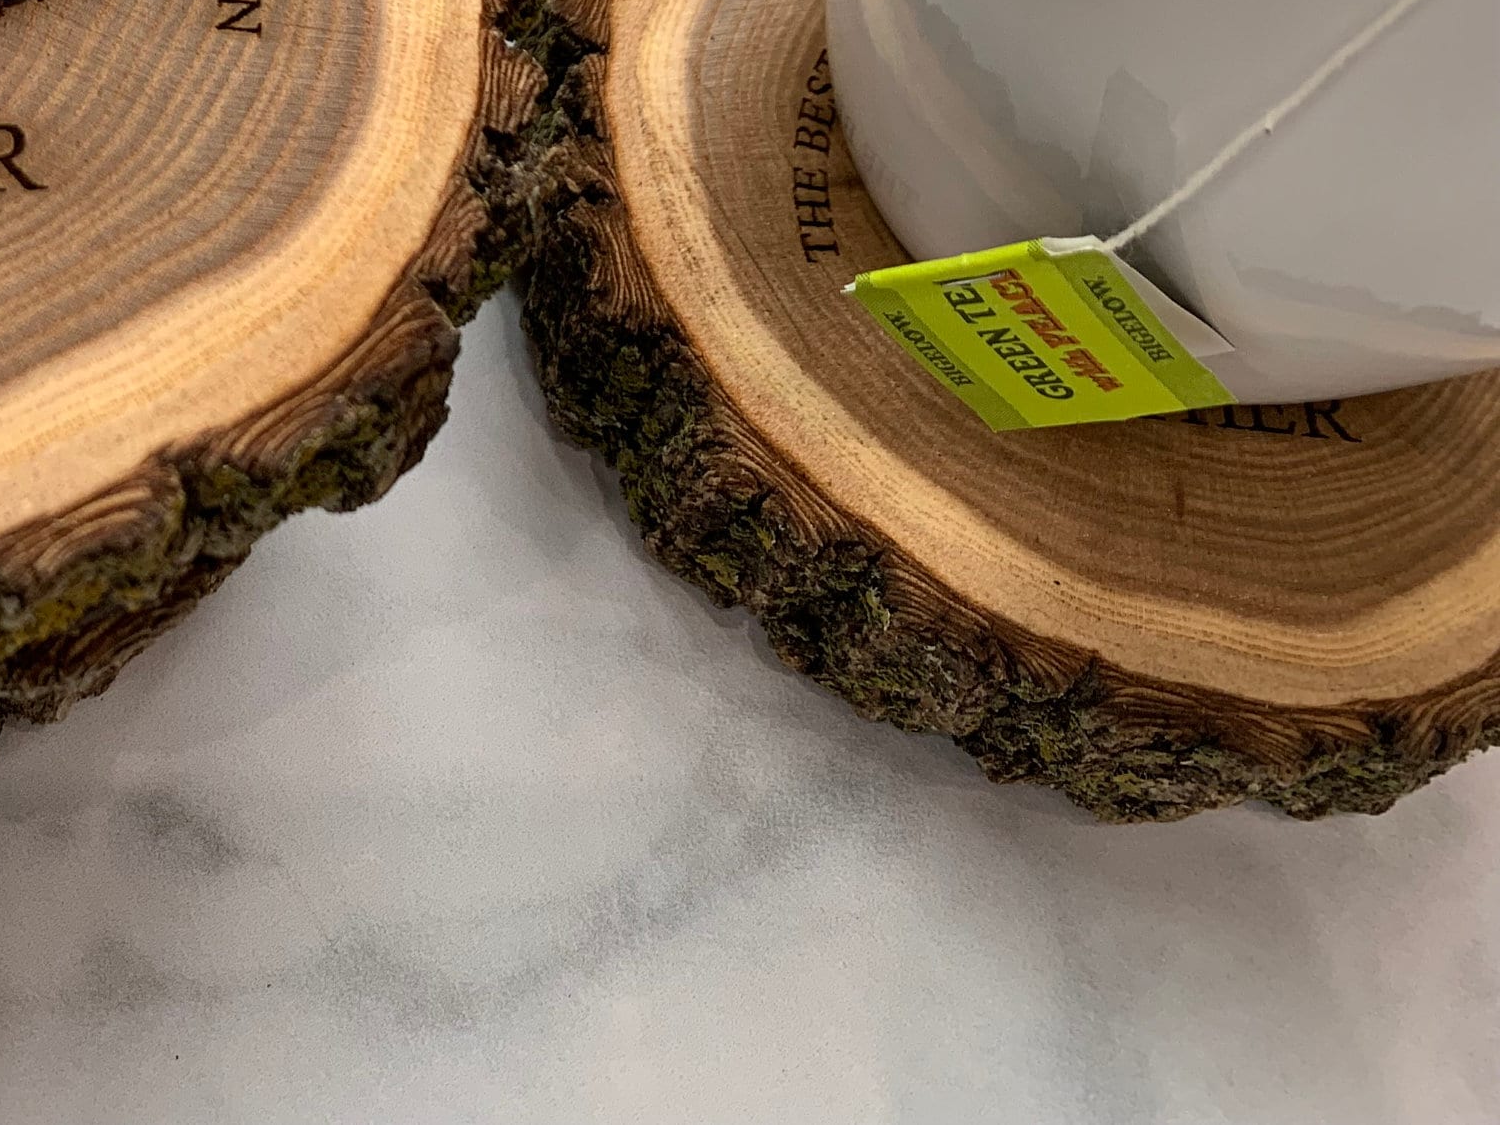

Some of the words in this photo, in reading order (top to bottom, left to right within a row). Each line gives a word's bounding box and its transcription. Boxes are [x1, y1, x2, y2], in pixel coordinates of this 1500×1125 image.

[793, 167, 841, 263] THE
[934, 277, 998, 324] TE
[1082, 276, 1175, 363] BIGELOW
[882, 309, 976, 387] BIGELOW
[976, 327, 1075, 401] GREEN
